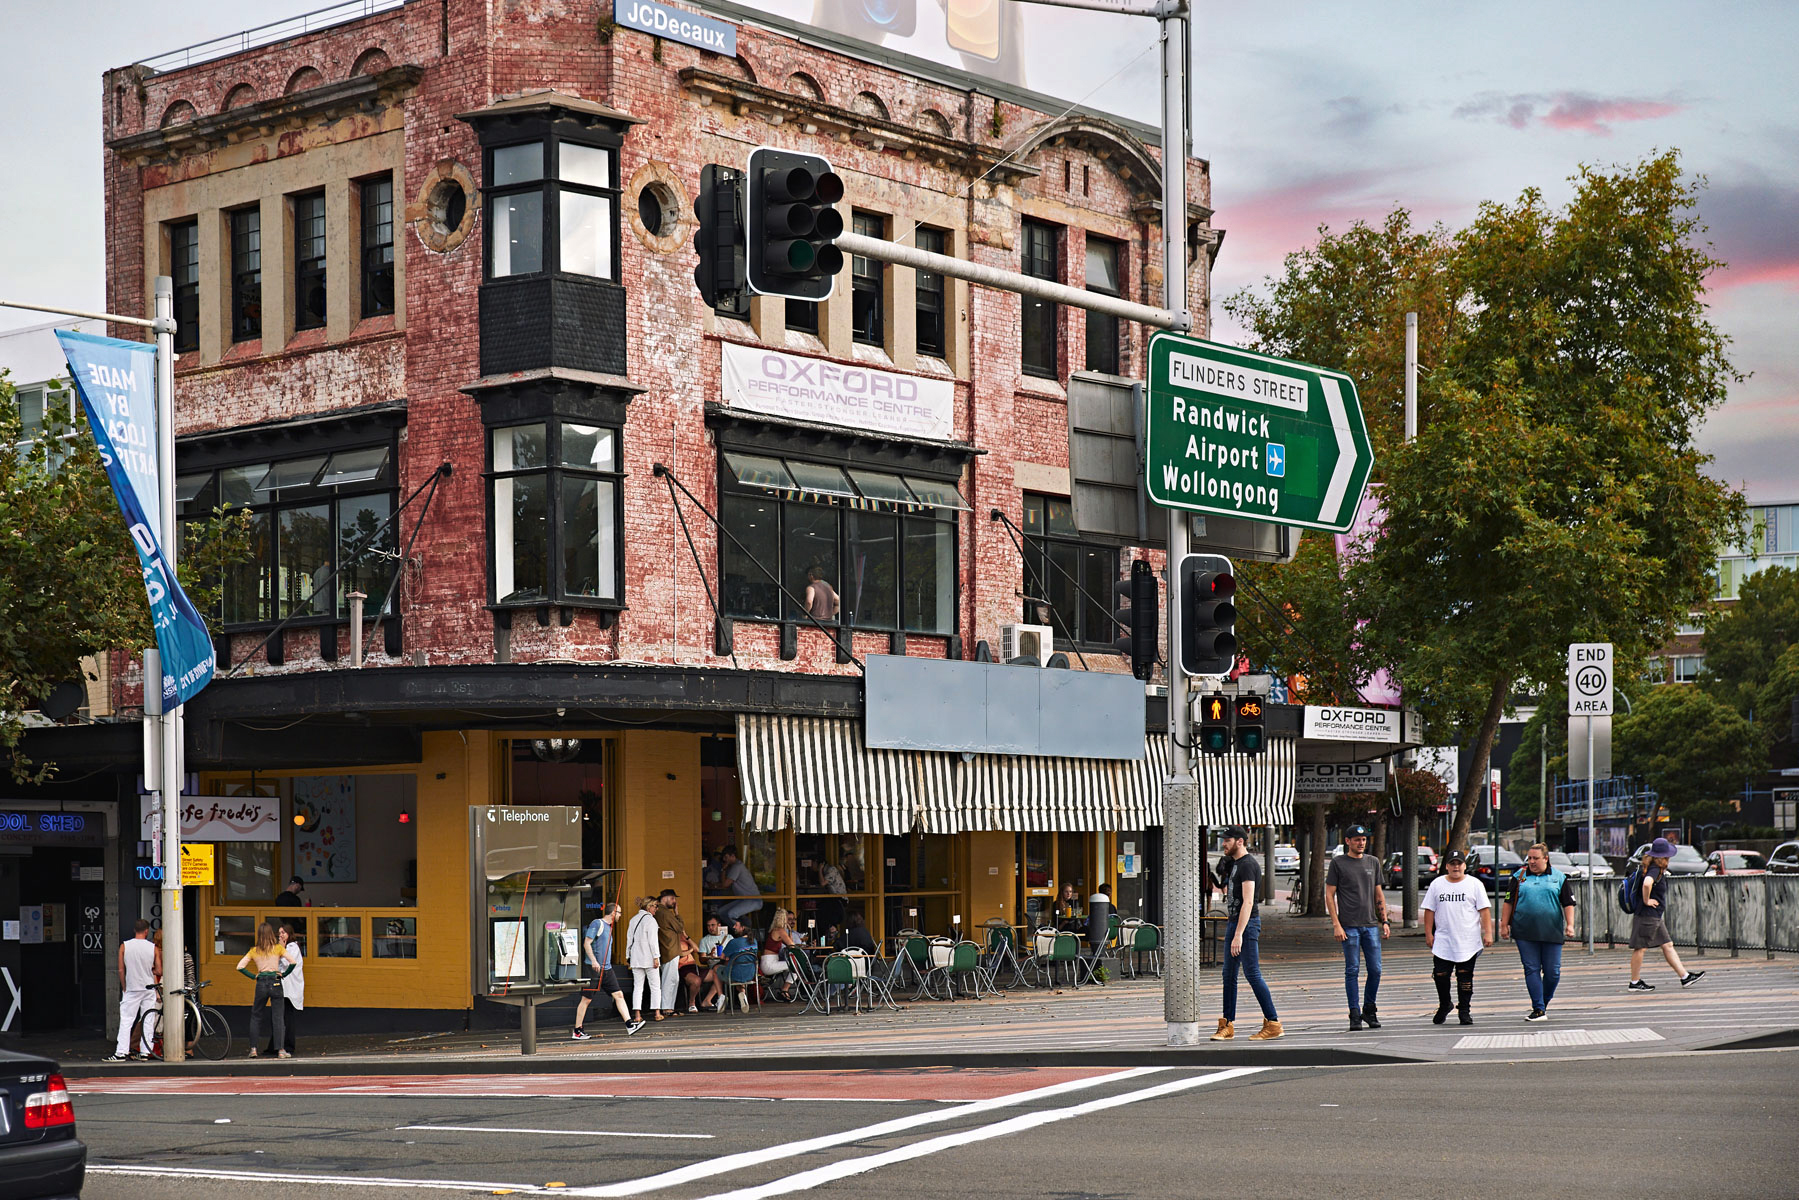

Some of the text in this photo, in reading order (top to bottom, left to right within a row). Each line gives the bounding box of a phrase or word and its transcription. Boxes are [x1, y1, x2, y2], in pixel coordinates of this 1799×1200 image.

[627, 2, 726, 49] JCDecaux
[761, 355, 918, 402] OXFORD
[1173, 360, 1304, 404] FLINDERS STREET
[748, 378, 869, 408] PERFORMANCE
[872, 398, 933, 418] CENTRE
[1173, 396, 1270, 439] Randwick
[1185, 434, 1259, 470] Airport
[1163, 463, 1279, 515] Wollongong
[1577, 648, 1606, 662] END
[1579, 673, 1602, 689] 40
[1574, 700, 1608, 712] AREA
[1320, 709, 1386, 724] OXFORD
[1314, 721, 1392, 732] PERFORMANCE CENTRE
[1296, 764, 1372, 776] FORD
[209, 803, 261, 822] freda's
[501, 809, 550, 825] Telephone
[40, 814, 85, 832] SHED
[1439, 891, 1467, 903] saint
[82, 924, 103, 932] THE
[82, 933, 103, 949] OX
[20, 1074, 47, 1083] 325i
